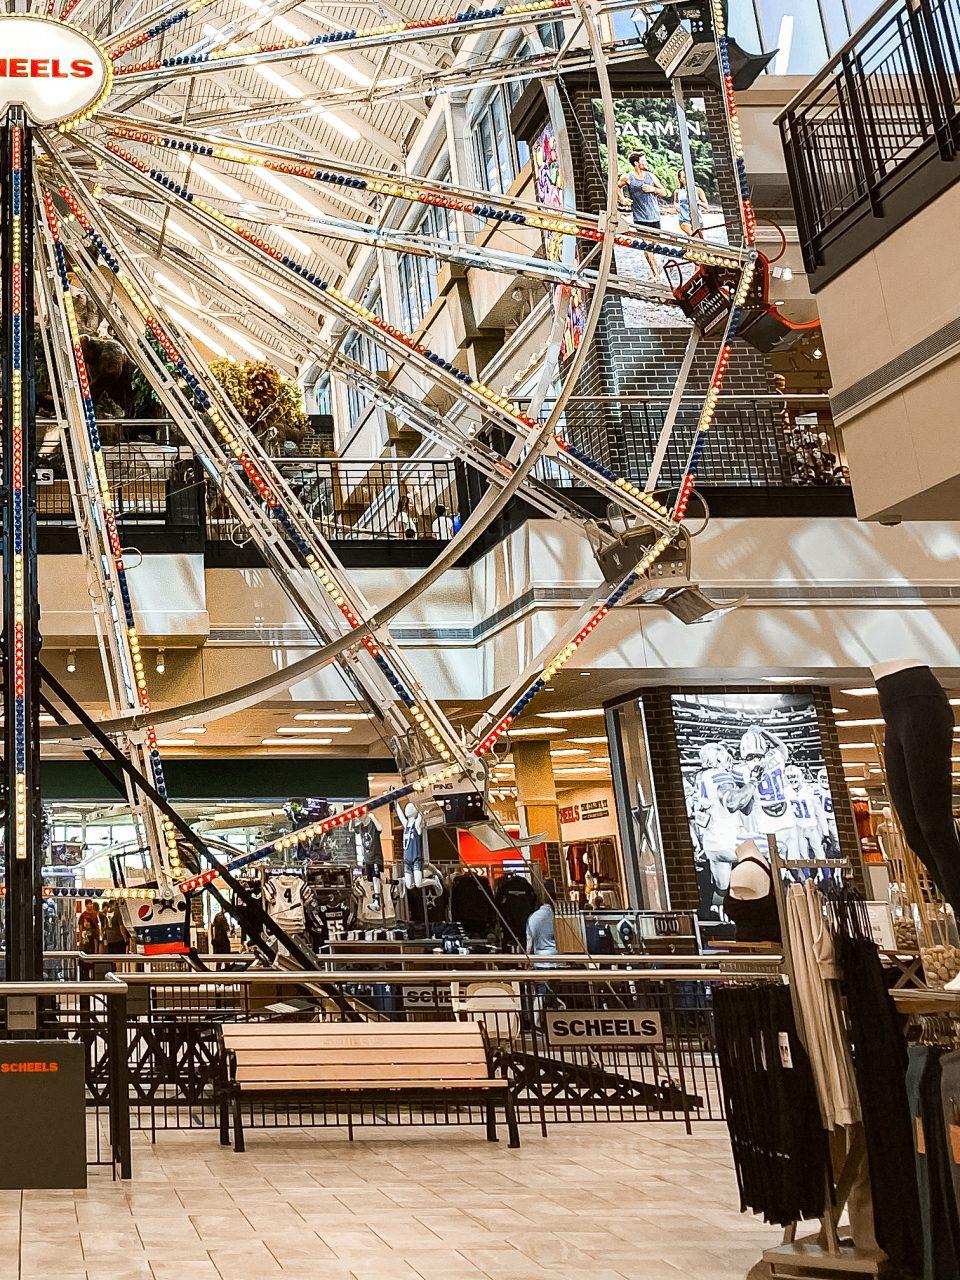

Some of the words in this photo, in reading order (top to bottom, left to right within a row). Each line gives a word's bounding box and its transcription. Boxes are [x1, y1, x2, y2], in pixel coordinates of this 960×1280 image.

[406, 990, 467, 1004] SCHE
[552, 1019, 657, 1036] SCHEELS
[0, 1062, 58, 1073] SCHEELS
